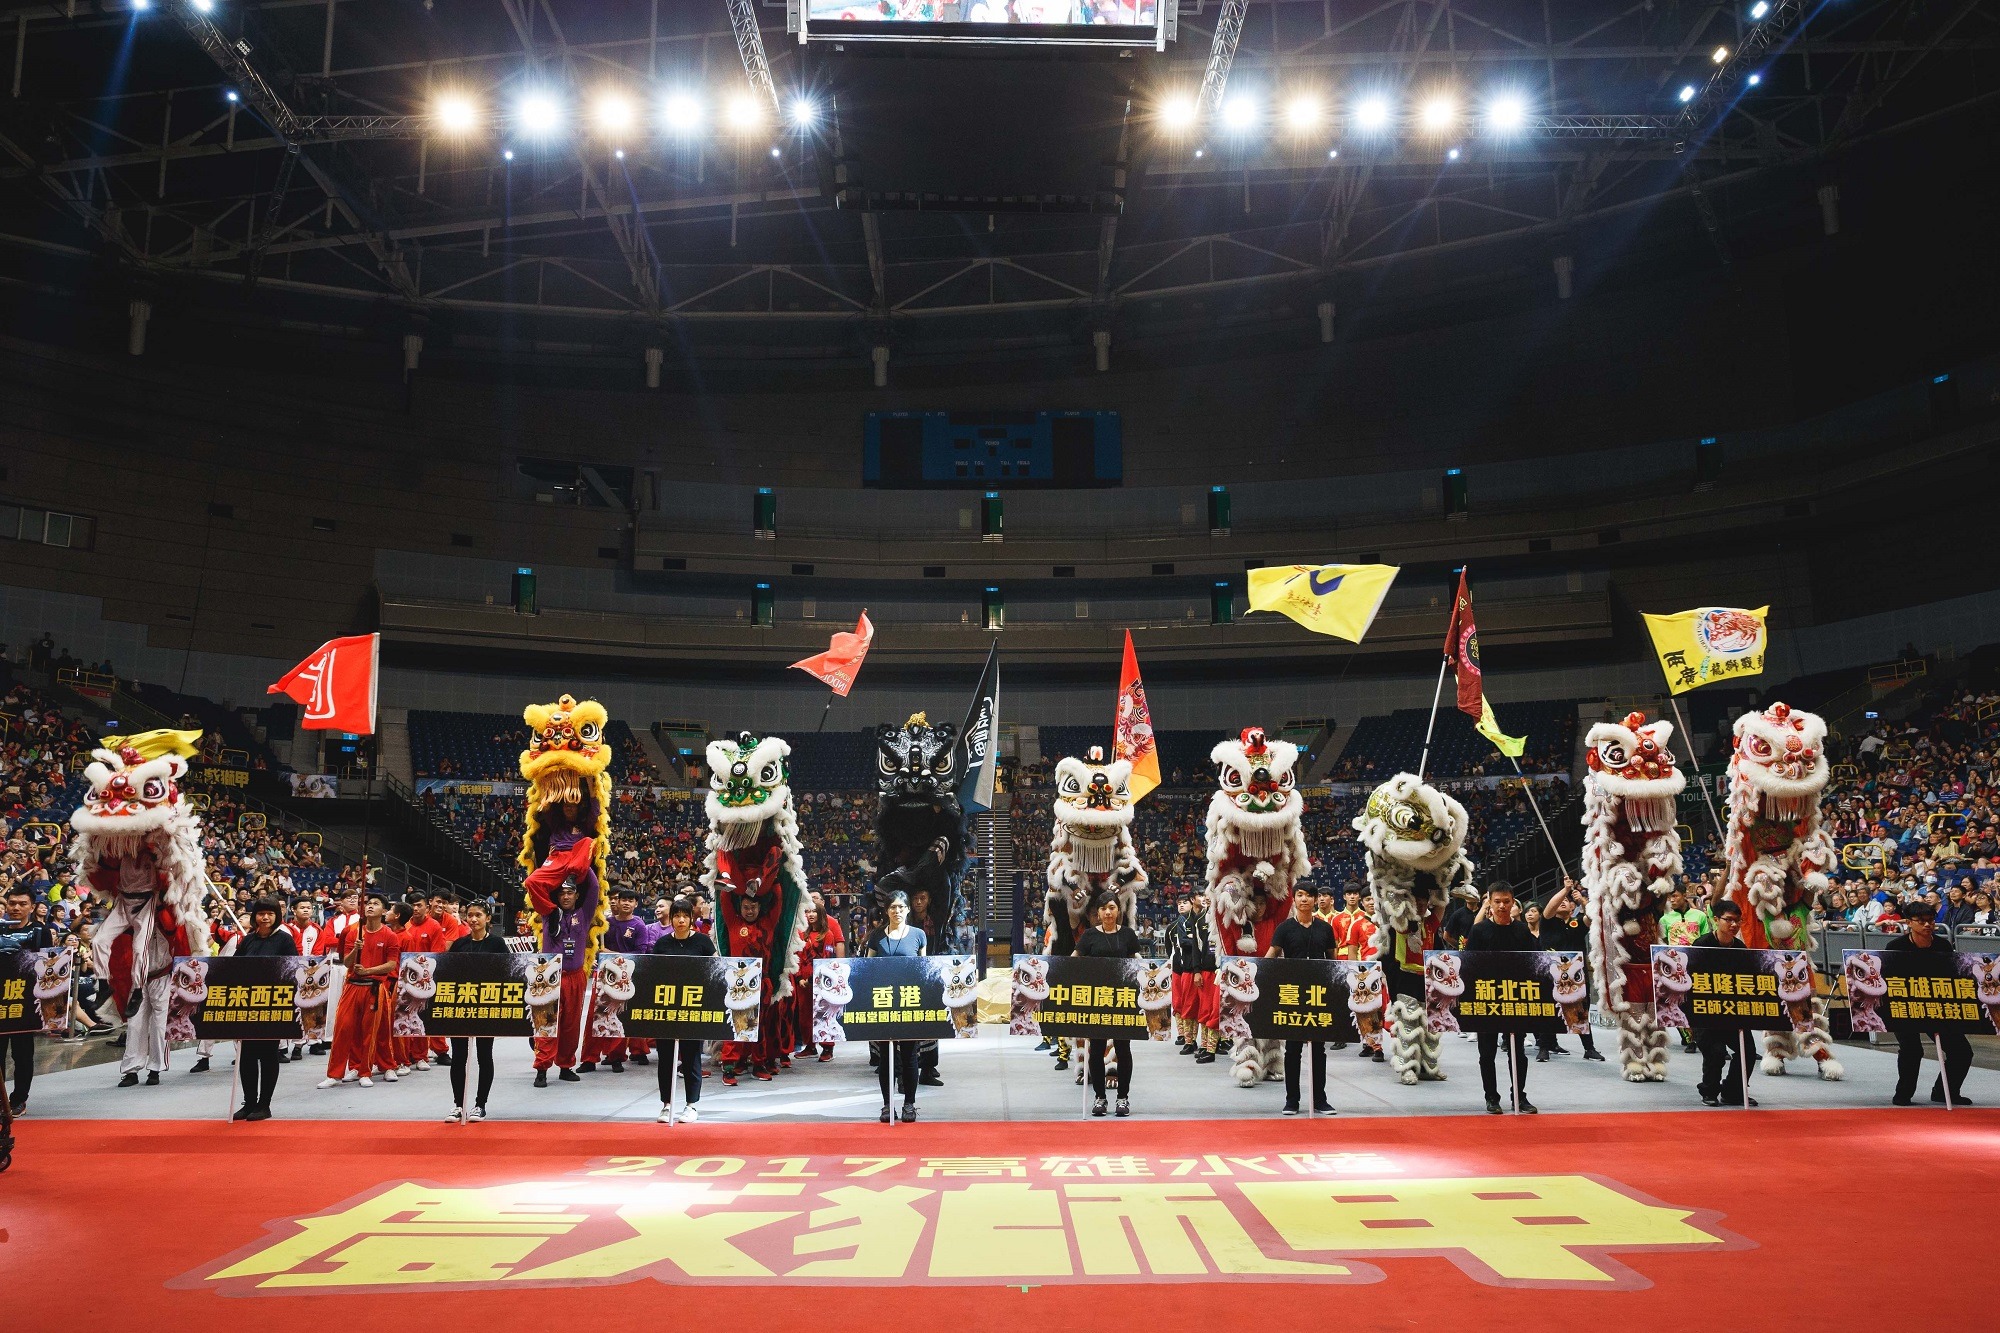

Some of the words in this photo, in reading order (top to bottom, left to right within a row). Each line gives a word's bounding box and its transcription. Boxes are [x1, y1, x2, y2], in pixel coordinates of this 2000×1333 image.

[1680, 791, 1713, 802] TOILET
[3, 978, 26, 1000] 坡
[434, 982, 526, 1004] 馬來西亞
[1278, 983, 1327, 1007] 臺北
[1474, 979, 1541, 1001] 新北市
[1691, 972, 1777, 996] 基隆長興
[1885, 976, 1977, 1000] 高雄兩廣
[206, 985, 295, 1007] 馬來西亞
[654, 984, 704, 1008] 印尼
[872, 985, 921, 1008] 香港
[1049, 984, 1137, 1008] 中國廣東
[432, 1006, 524, 1019] 吉隆坡光藝龍獅團
[630, 1008, 725, 1023] 廣肇江夏堂龍獅團
[1272, 1010, 1333, 1028] 市立大學
[1459, 1001, 1556, 1017] 臺灣文揚龍獅團
[1693, 999, 1779, 1017] 呂師父龍獅團
[1889, 1001, 1980, 1021] 龍獅戰鼓團
